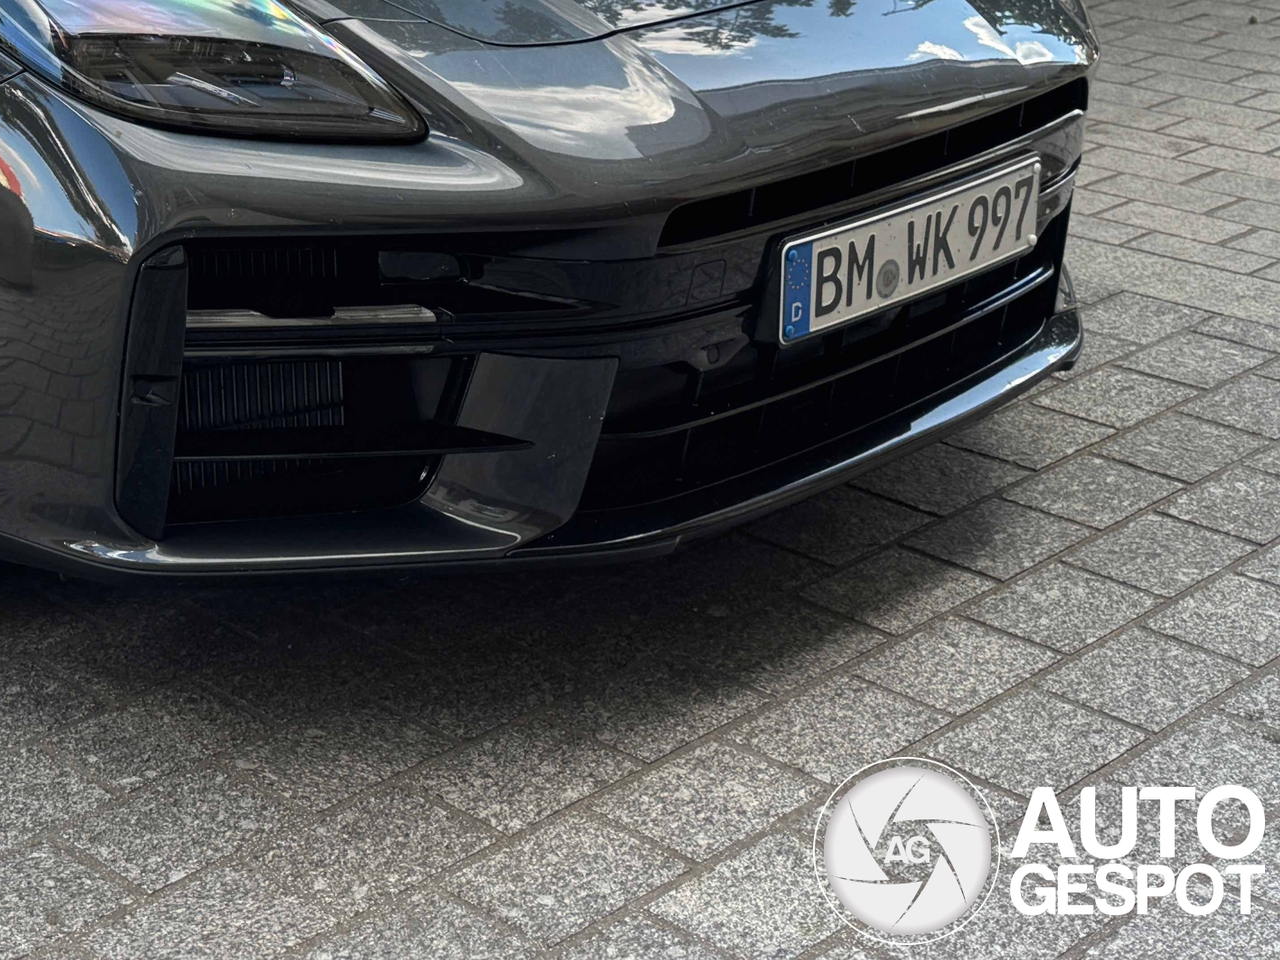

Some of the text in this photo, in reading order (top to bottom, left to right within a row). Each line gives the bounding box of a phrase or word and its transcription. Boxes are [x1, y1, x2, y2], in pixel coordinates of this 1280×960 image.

[814, 174, 1035, 319] BM WK 997
[791, 301, 803, 322] D
